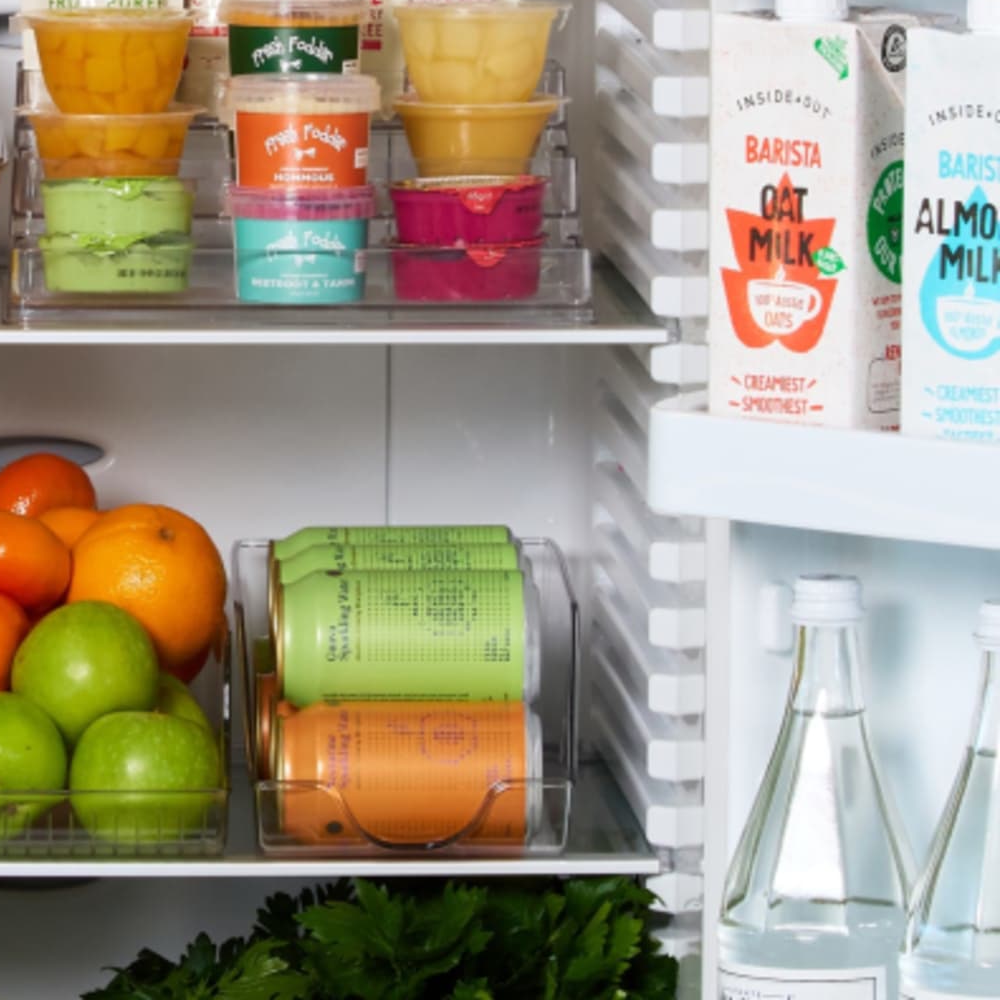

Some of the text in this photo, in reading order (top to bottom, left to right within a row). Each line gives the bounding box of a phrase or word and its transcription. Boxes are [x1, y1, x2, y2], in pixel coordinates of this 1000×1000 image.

[736, 89, 793, 111] INSIDE
[928, 104, 984, 127] INSIDE
[745, 135, 822, 168] BARISTA
[938, 149, 1000, 184] BARIST
[760, 184, 808, 224] OAT
[914, 197, 997, 240] ALMO
[749, 227, 814, 268] MILK
[744, 374, 805, 392] CREAMIEST
[742, 396, 808, 415] SMOOTHEST
